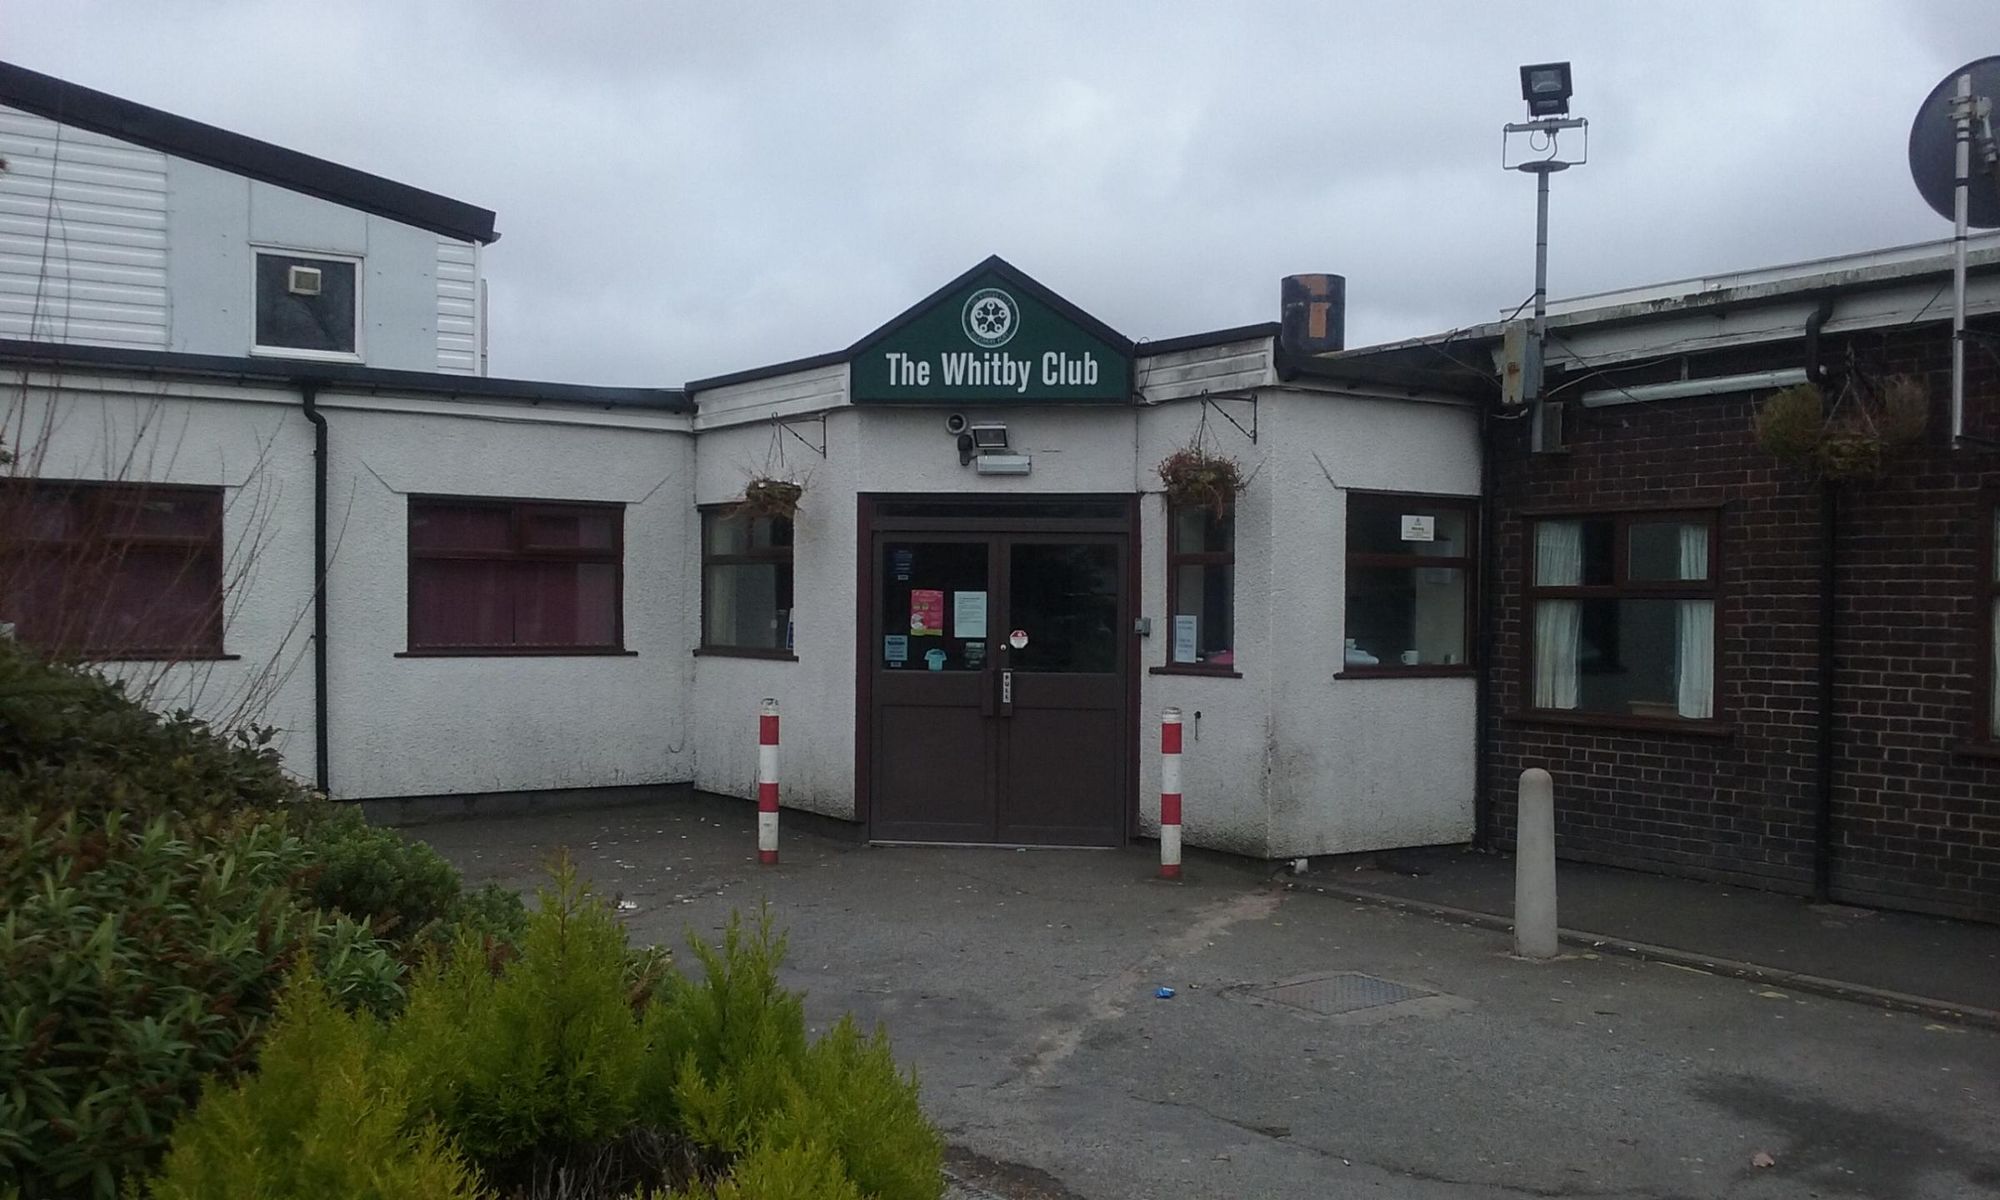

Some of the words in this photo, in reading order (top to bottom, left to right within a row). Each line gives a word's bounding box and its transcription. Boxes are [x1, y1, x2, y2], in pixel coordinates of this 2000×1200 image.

[886, 353, 930, 385] The
[941, 352, 1031, 392] Whitby
[1042, 352, 1098, 385] Club
